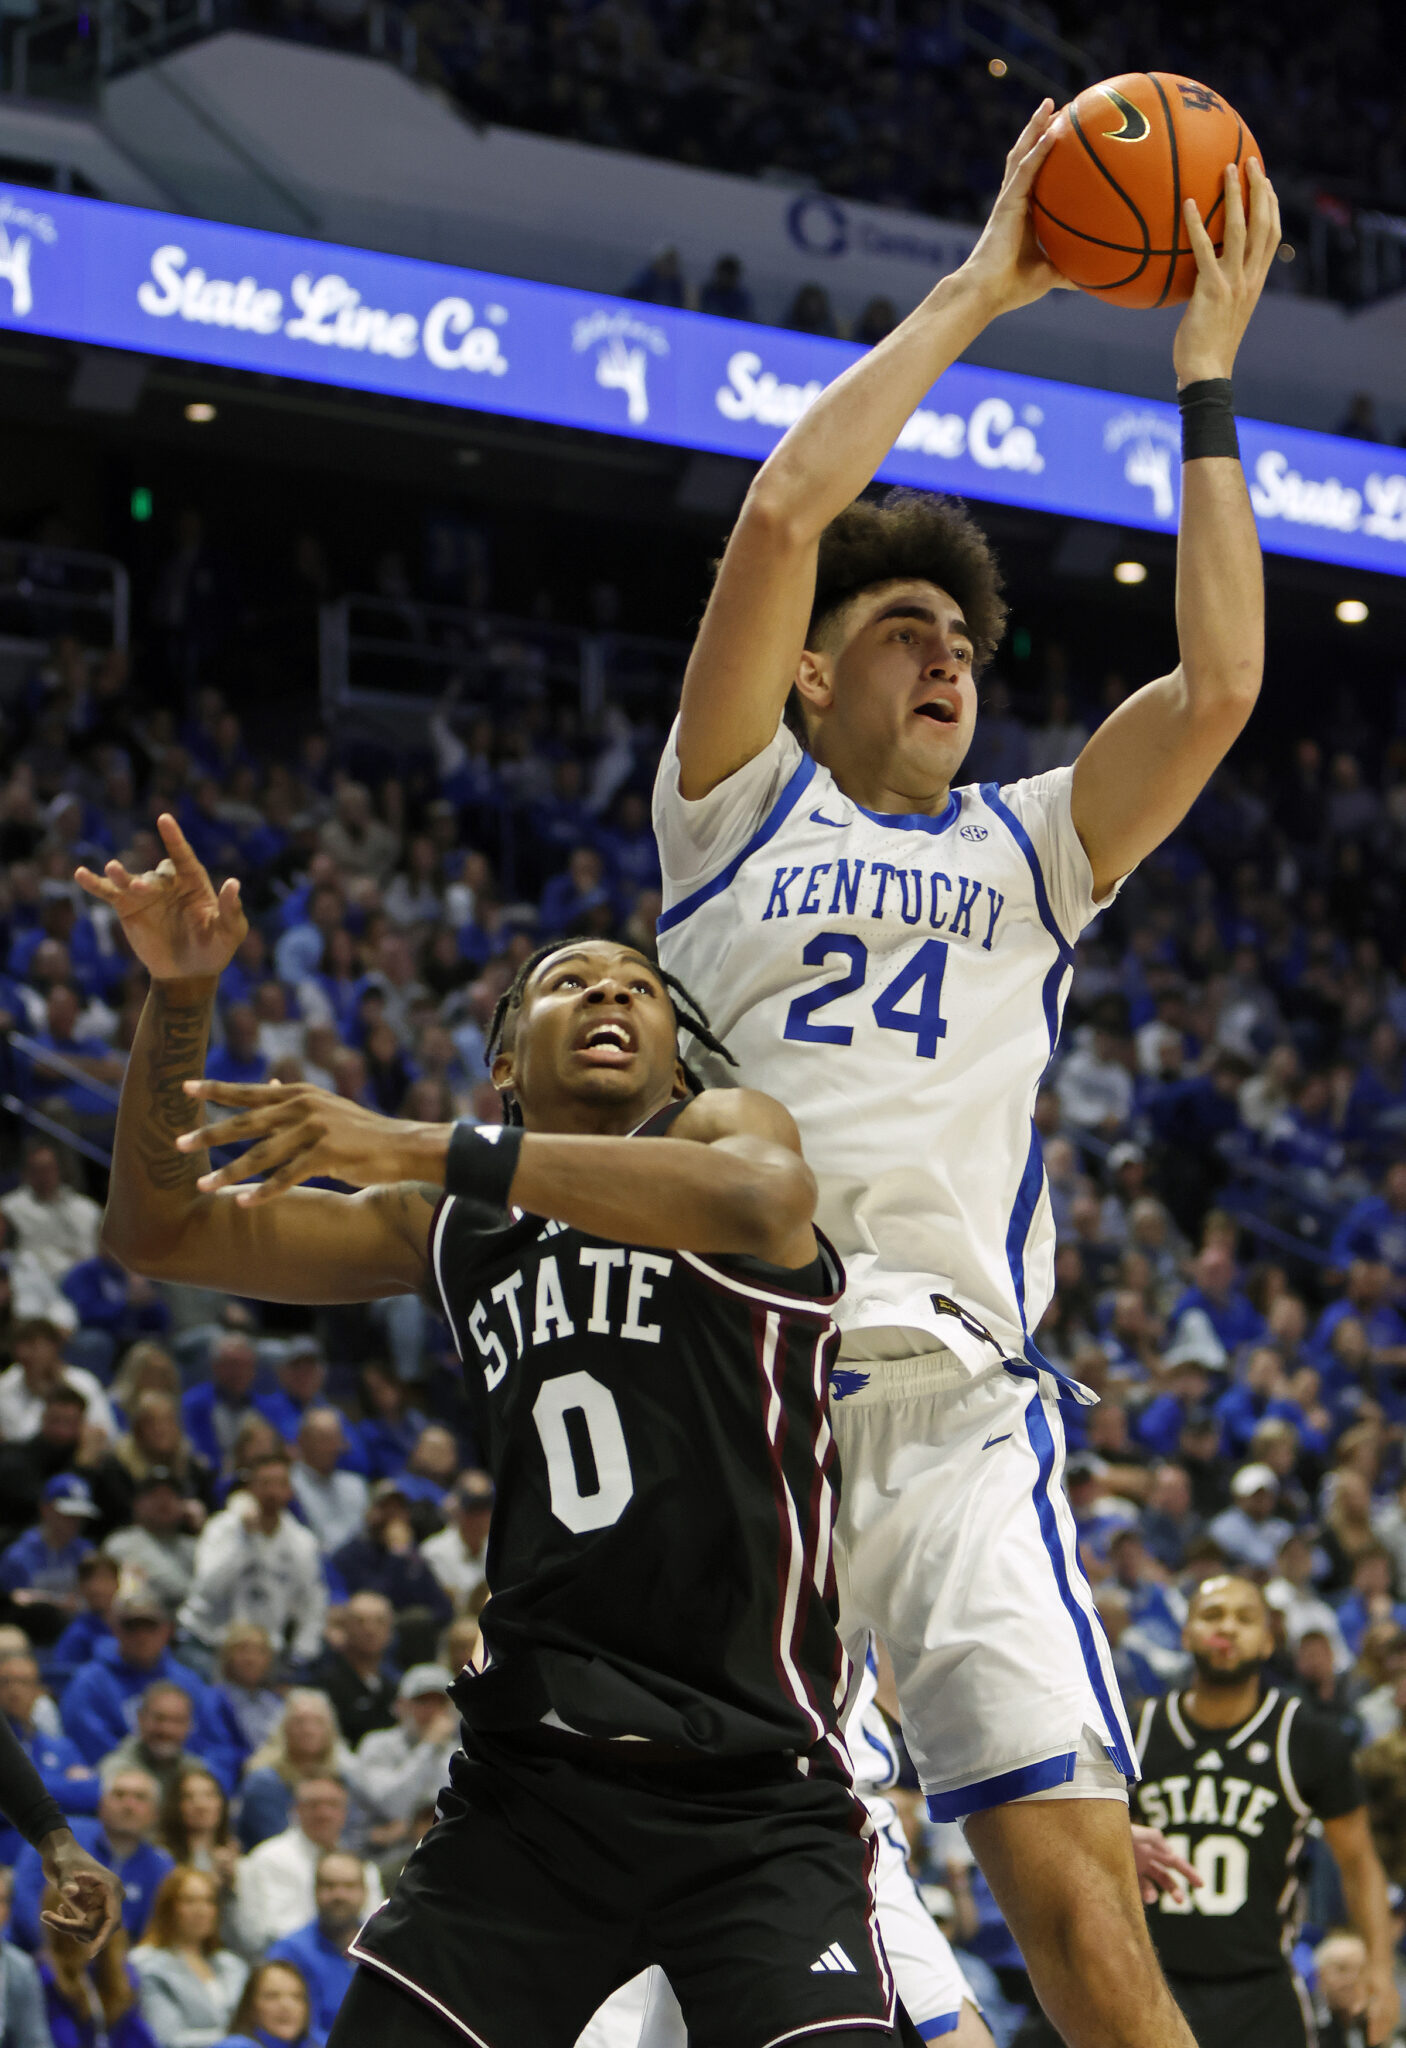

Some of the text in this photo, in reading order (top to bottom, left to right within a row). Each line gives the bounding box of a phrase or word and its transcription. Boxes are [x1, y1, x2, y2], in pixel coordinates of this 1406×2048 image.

[137, 245, 283, 334] State
[285, 271, 418, 358] Line
[1250, 450, 1362, 533] State
[961, 825, 988, 841] SEC
[762, 859, 1004, 951] KENTUCKY
[783, 932, 949, 1060] 24
[468, 1247, 673, 1392] STATE
[532, 1370, 634, 1534] 0
[1138, 1774, 1279, 1838] STATE
